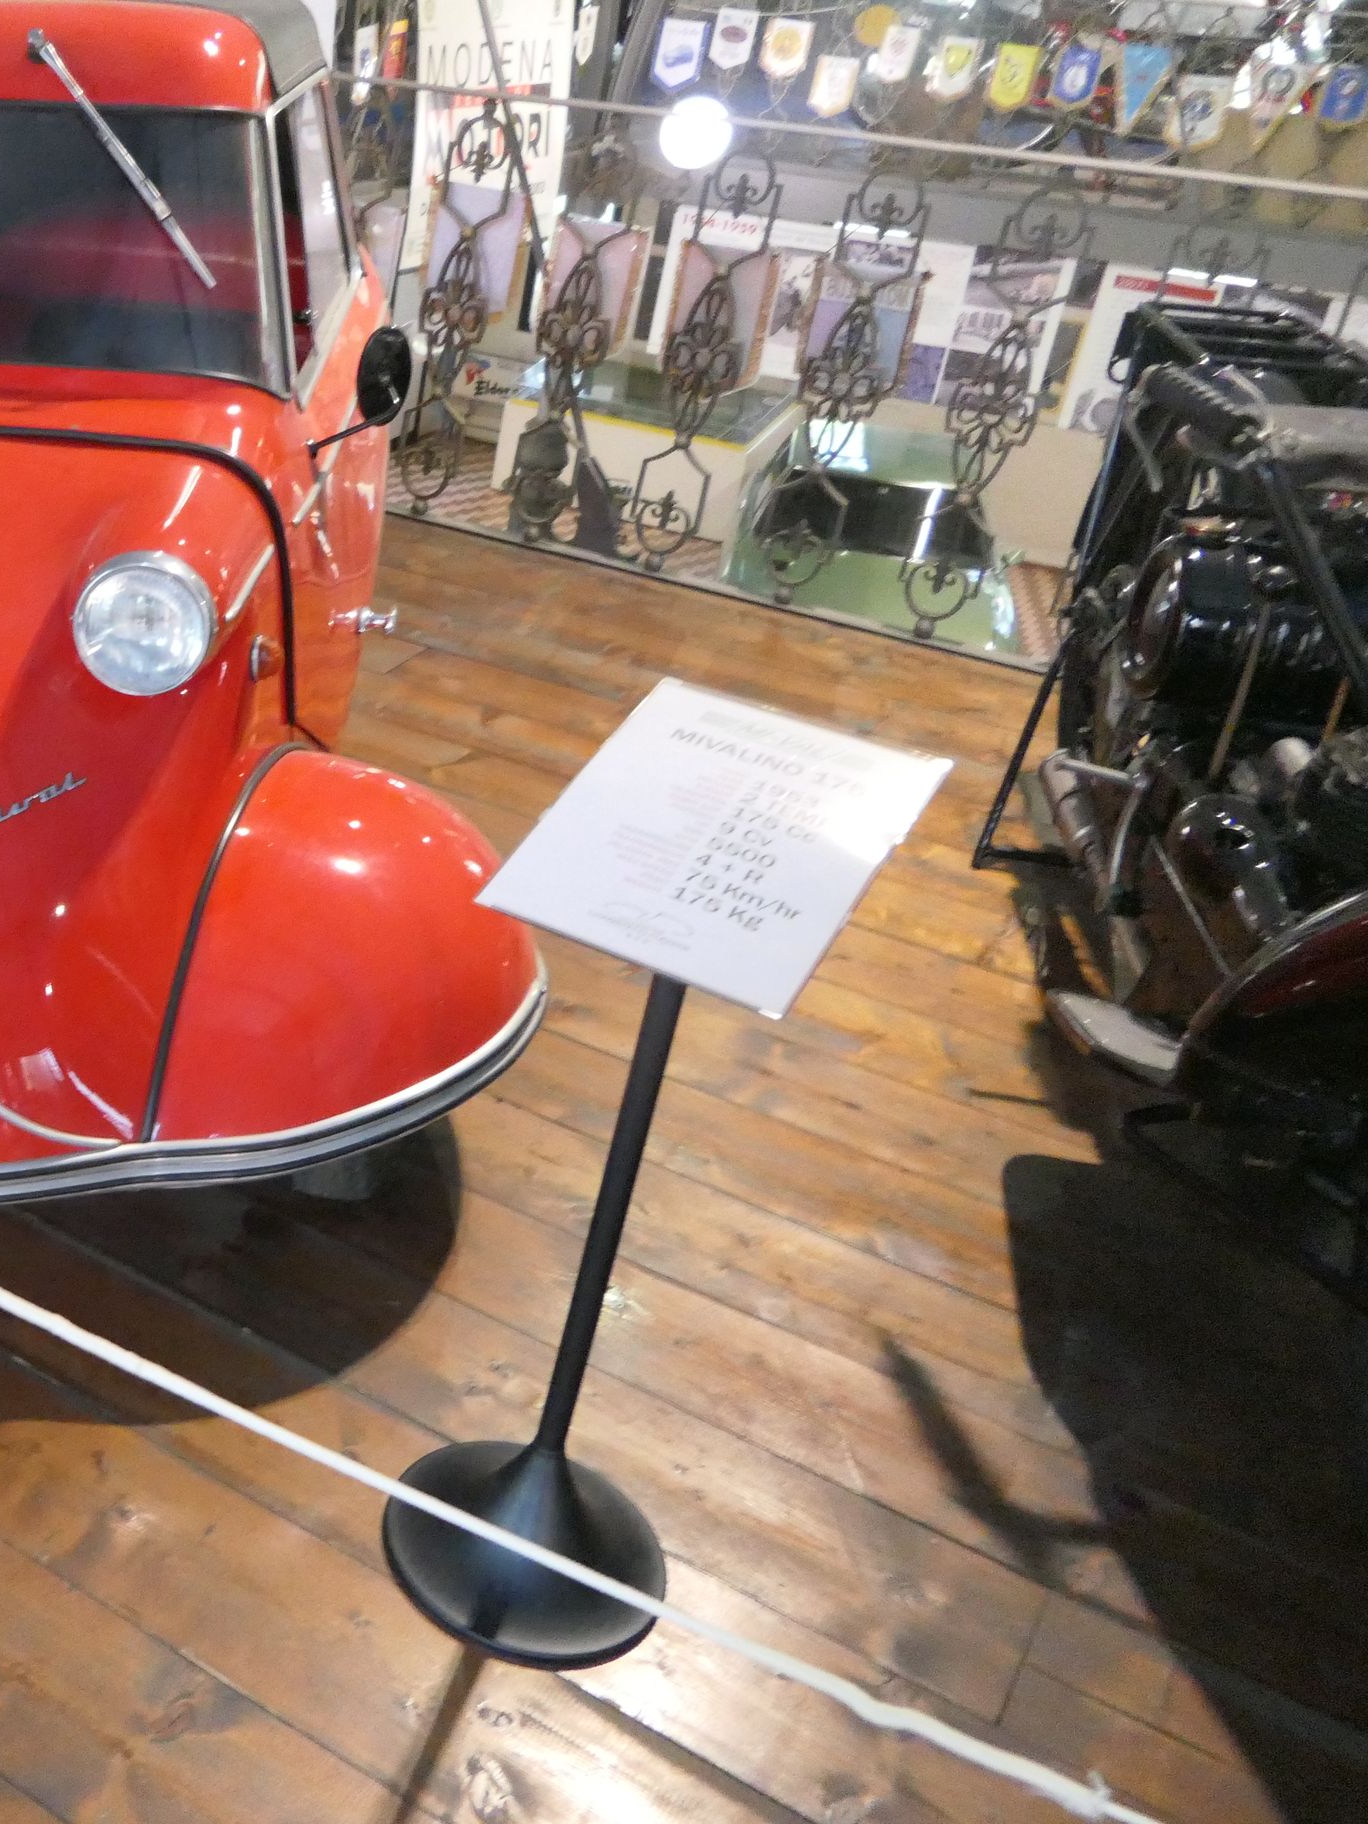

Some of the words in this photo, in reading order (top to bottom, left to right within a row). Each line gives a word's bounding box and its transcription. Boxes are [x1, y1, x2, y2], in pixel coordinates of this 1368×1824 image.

[426, 39, 552, 89] MODENA
[670, 728, 804, 777] MIVALINO
[671, 886, 721, 913] 175
[727, 904, 765, 932] Kg
[722, 882, 803, 920] Km/hr
